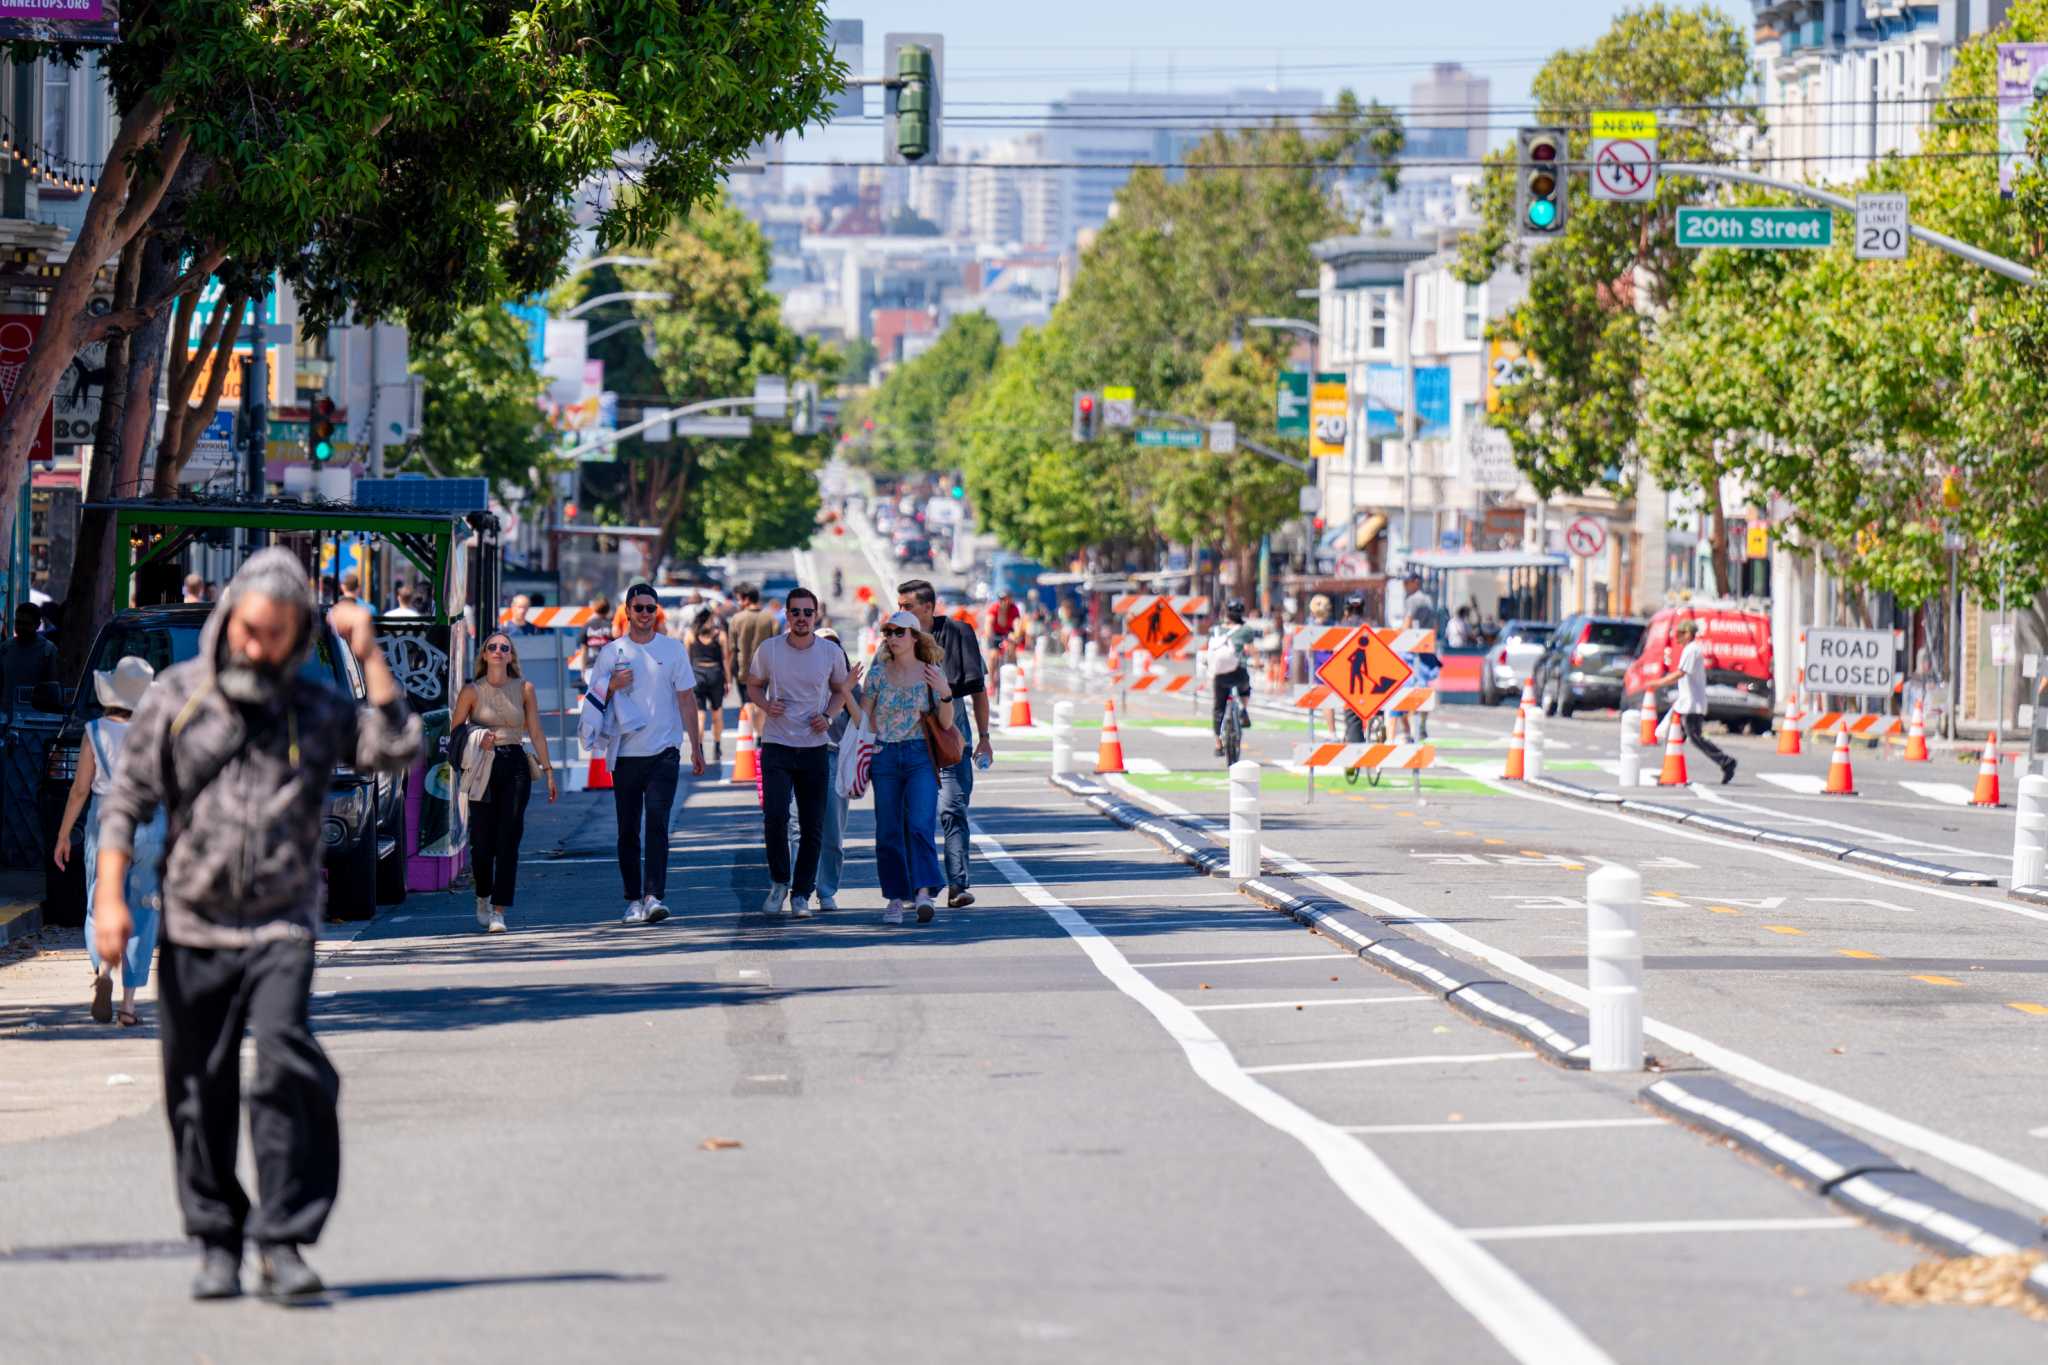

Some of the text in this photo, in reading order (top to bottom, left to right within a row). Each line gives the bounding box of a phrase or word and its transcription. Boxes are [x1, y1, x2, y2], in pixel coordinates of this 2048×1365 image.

[1603, 119, 1645, 132] NEW
[1861, 201, 1904, 210] SPEED
[1686, 216, 1821, 239] 20th Street
[1864, 213, 1897, 224] LIMIT
[1862, 228, 1901, 250] 20
[1315, 416, 1346, 440] 20
[1821, 638, 1879, 659] ROAD
[1807, 663, 1890, 686] CLOSED
